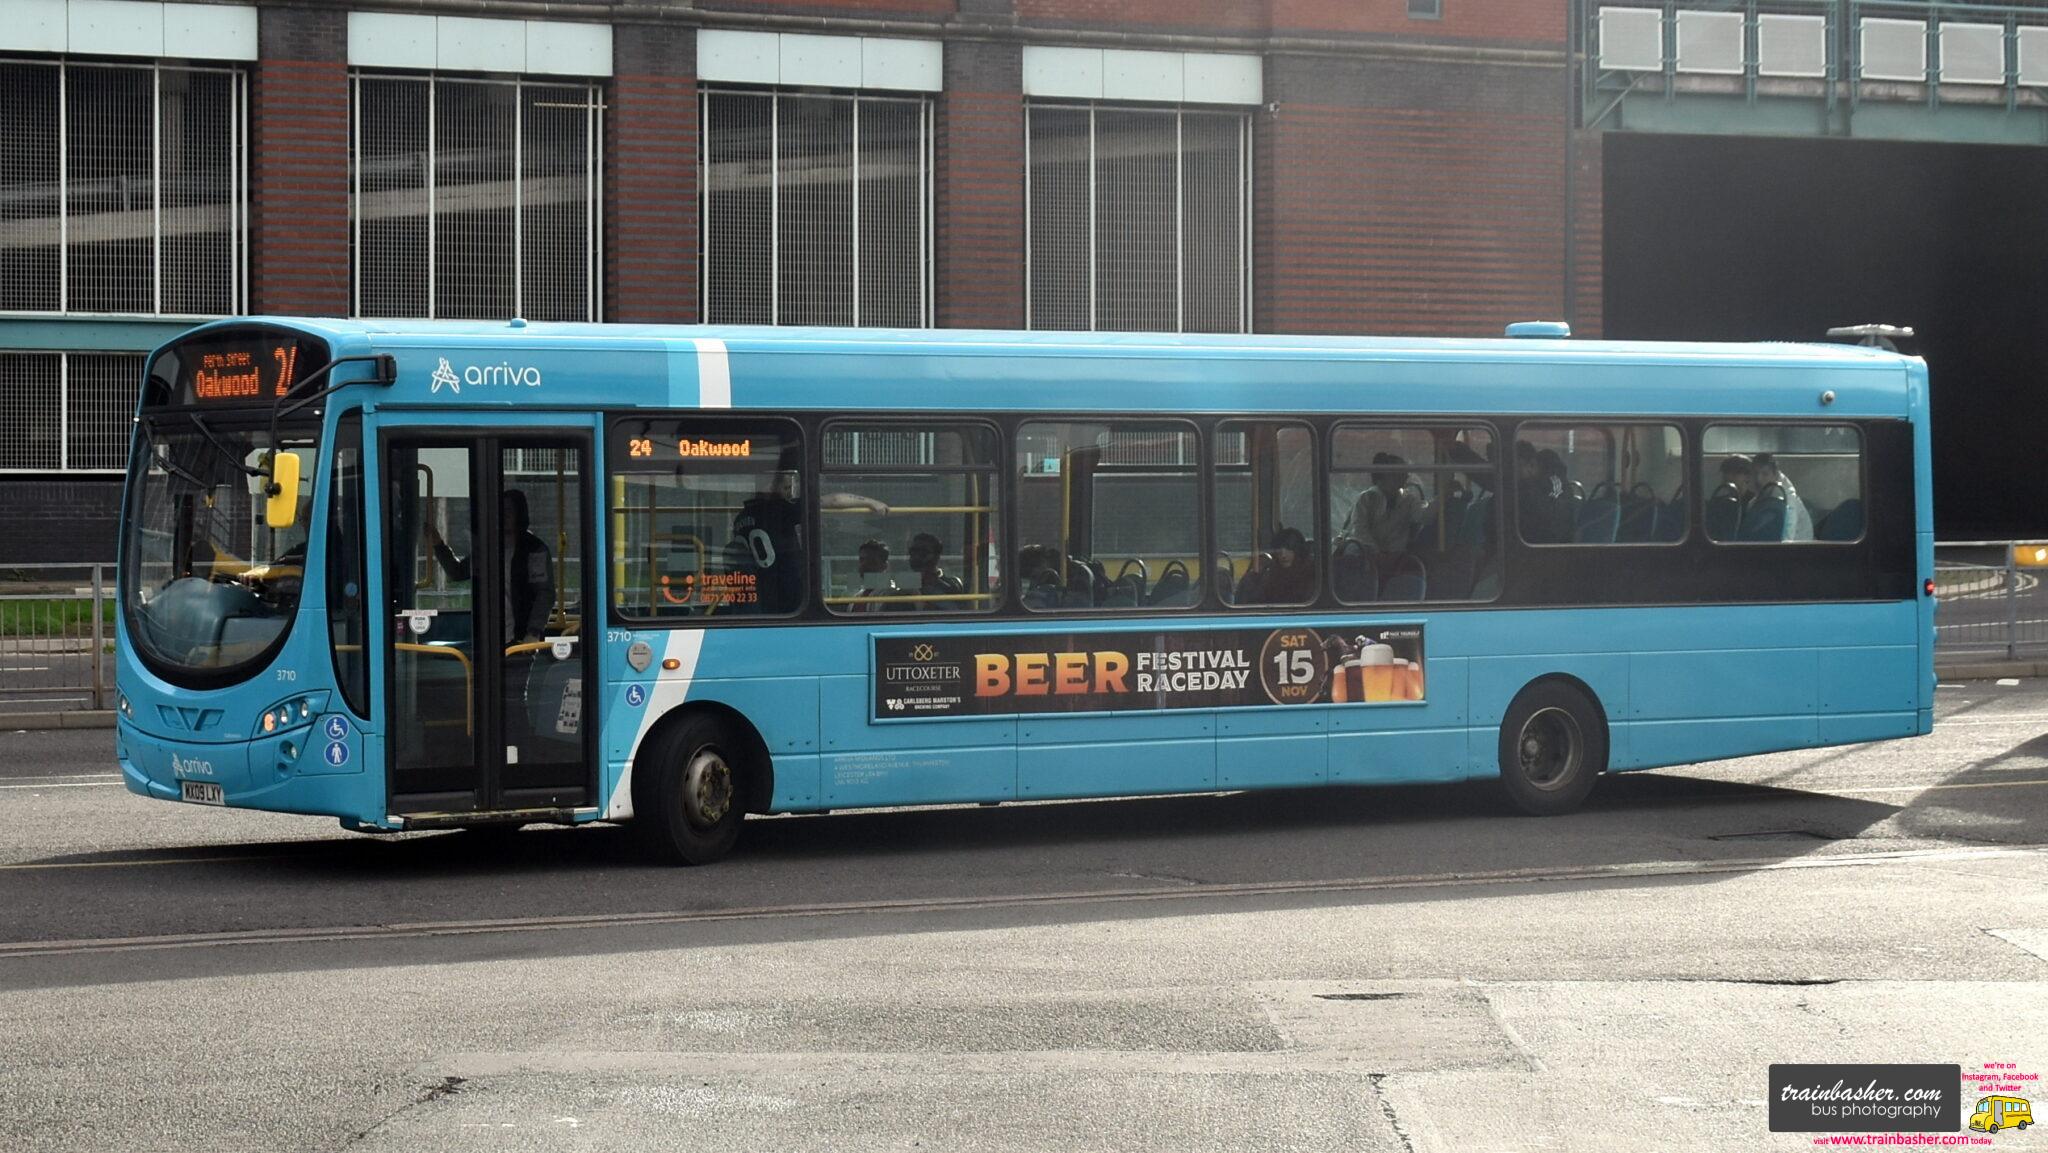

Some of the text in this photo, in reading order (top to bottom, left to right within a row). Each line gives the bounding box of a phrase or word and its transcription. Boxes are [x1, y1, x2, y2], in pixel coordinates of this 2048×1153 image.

[196, 366, 259, 398] Oakwood
[464, 361, 541, 386] arriva
[630, 439, 750, 456] 24 Oakwood
[702, 571, 756, 585] traveline
[737, 592, 746, 602] 22
[748, 592, 757, 602] 33
[607, 631, 632, 642] 3710
[1280, 635, 1308, 647] SAT
[1136, 650, 1250, 671] FESTIVAL
[1273, 649, 1315, 685] 15
[276, 670, 297, 681] 3710
[886, 666, 961, 680] UTTOXETER
[974, 651, 1131, 697] BEER
[1137, 670, 1250, 692] RACEDAY
[1281, 686, 1308, 697] NOV
[183, 757, 213, 776] arriva
[184, 783, 222, 801] MX09 LXY
